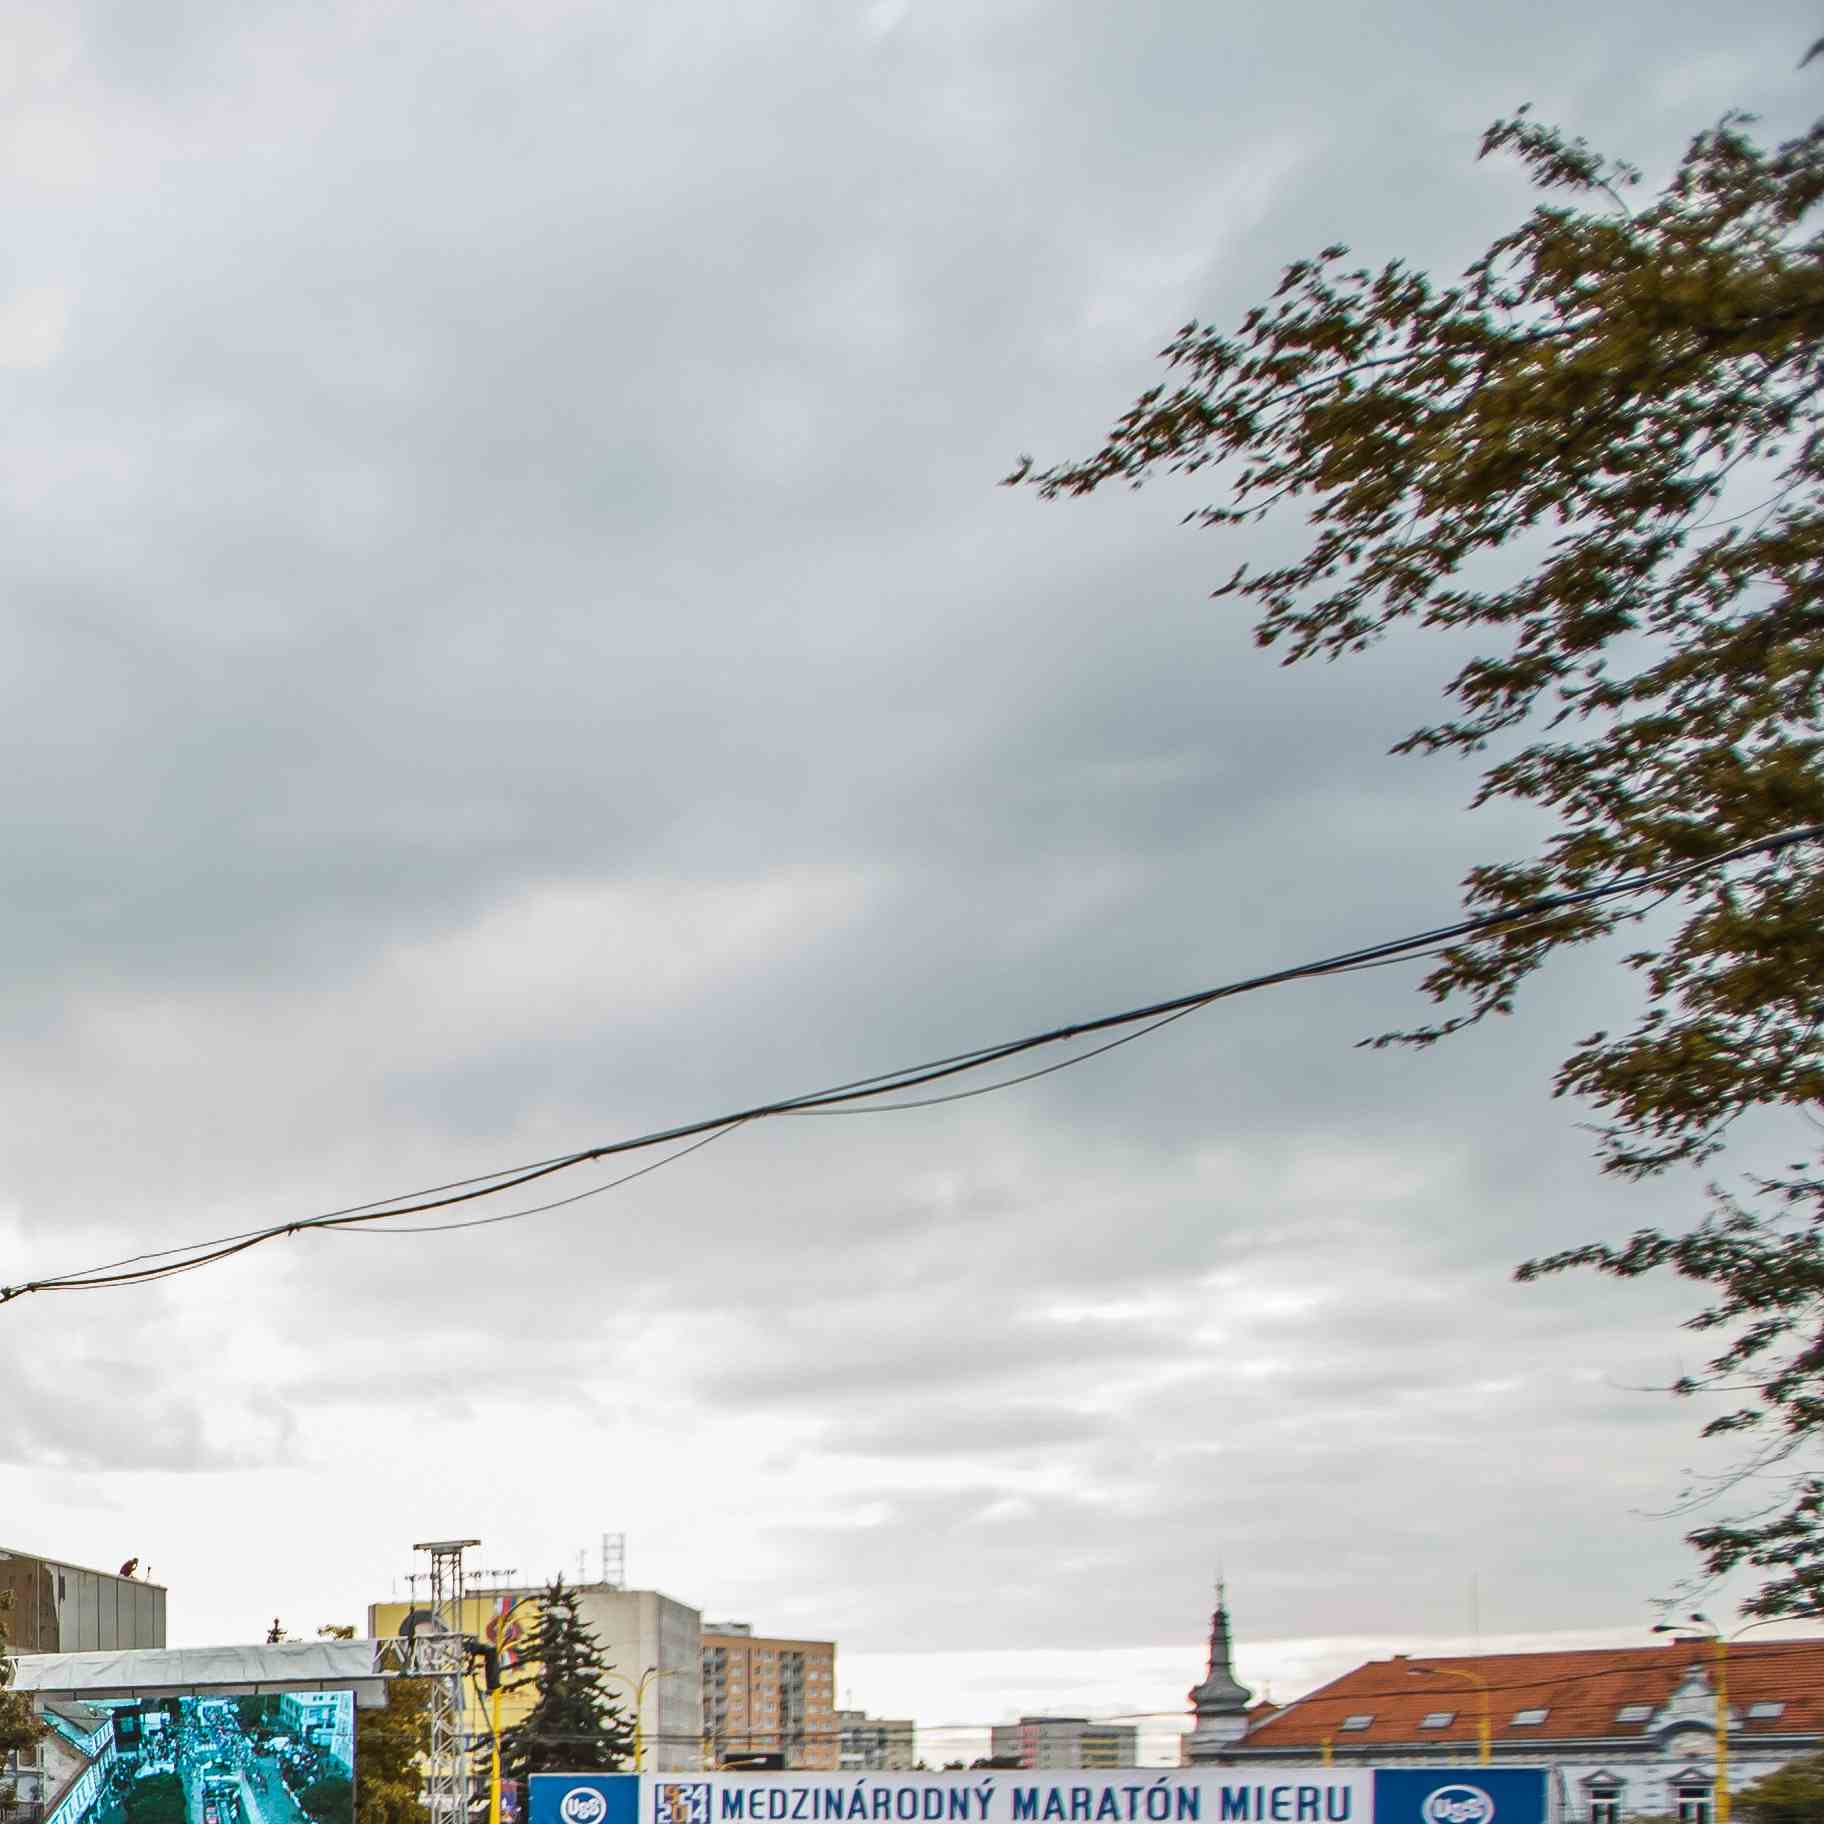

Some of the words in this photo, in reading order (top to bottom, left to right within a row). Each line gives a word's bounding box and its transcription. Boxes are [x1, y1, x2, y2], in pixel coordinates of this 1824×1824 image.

[720, 1777, 994, 1822] MEDZINÁRODNÝ
[1012, 1777, 1200, 1823] MARATÓN
[1220, 1785, 1352, 1823] MIERU
